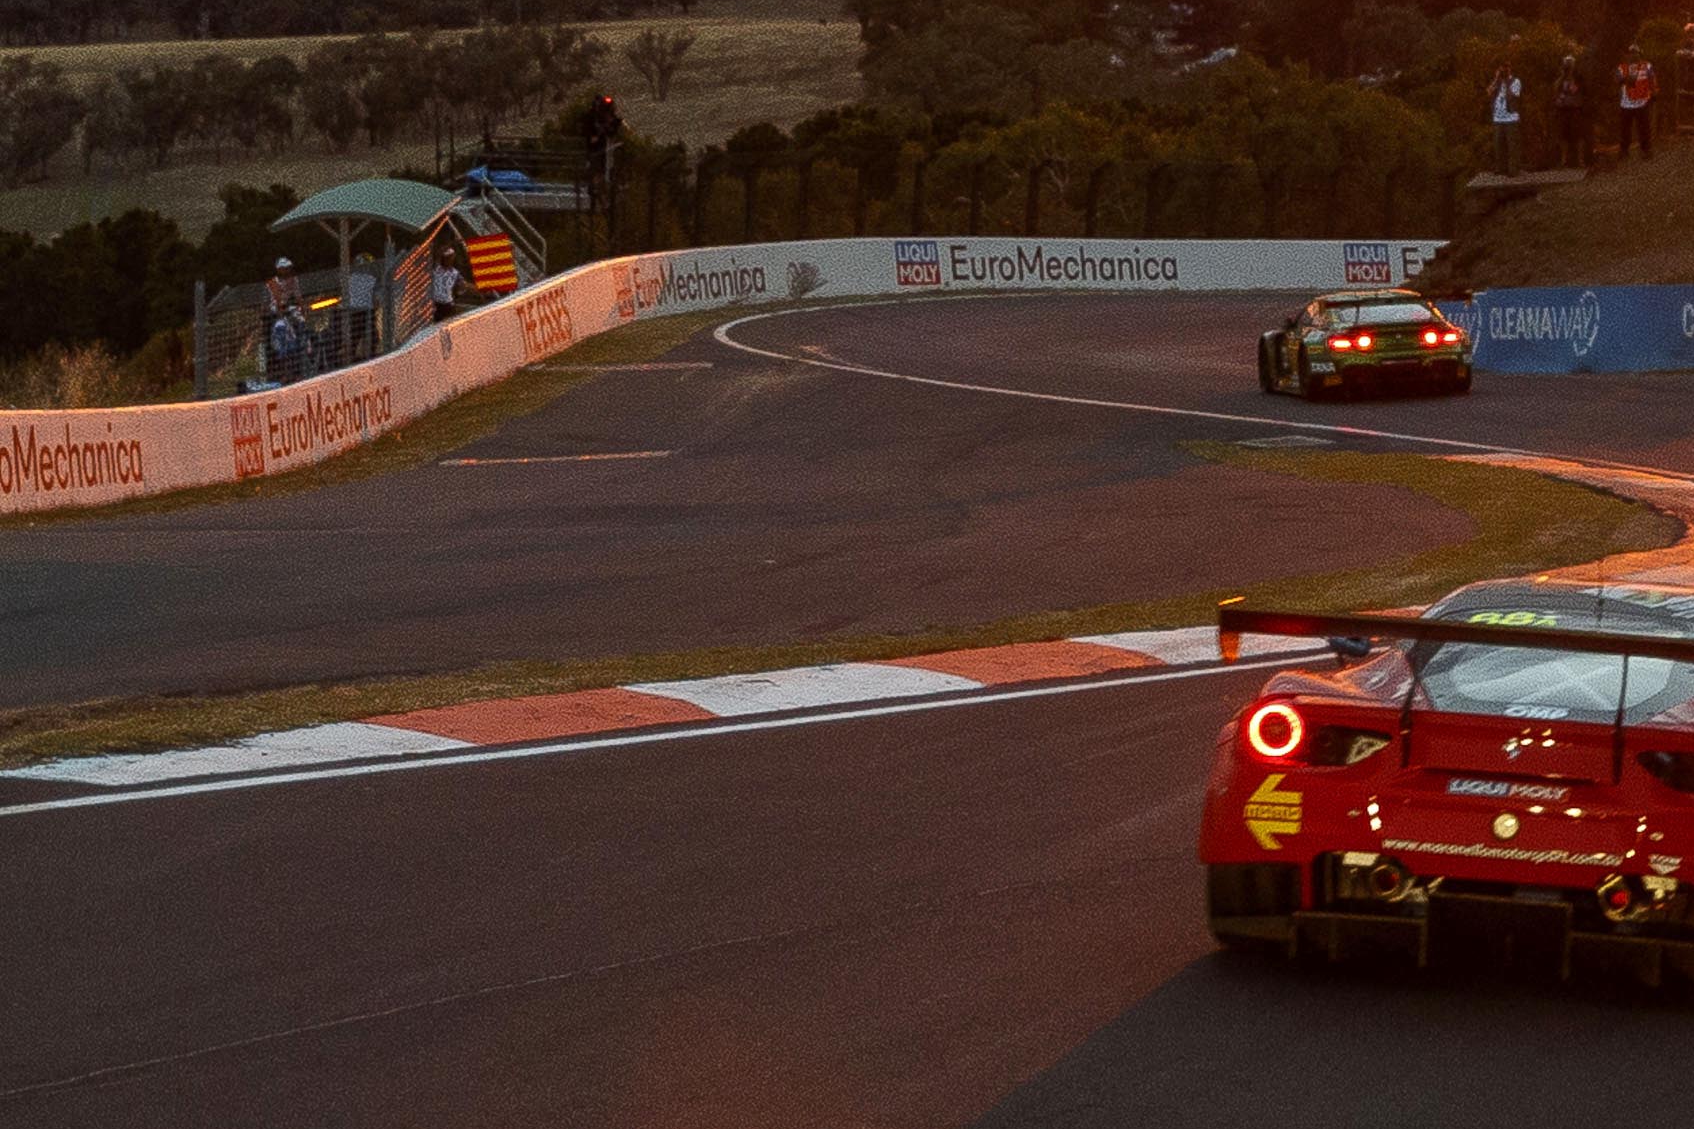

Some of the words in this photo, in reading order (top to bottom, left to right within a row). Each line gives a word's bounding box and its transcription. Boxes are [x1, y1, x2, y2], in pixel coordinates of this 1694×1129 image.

[898, 243, 936, 261] LIQUI
[1346, 246, 1387, 262] LIQUI
[950, 245, 1179, 281] EuroMechanica
[900, 264, 939, 282] MOLY
[1348, 265, 1389, 281] MOLY
[1490, 305, 1595, 340] CLEANAWAY
[267, 375, 391, 459] EuroMechanica
